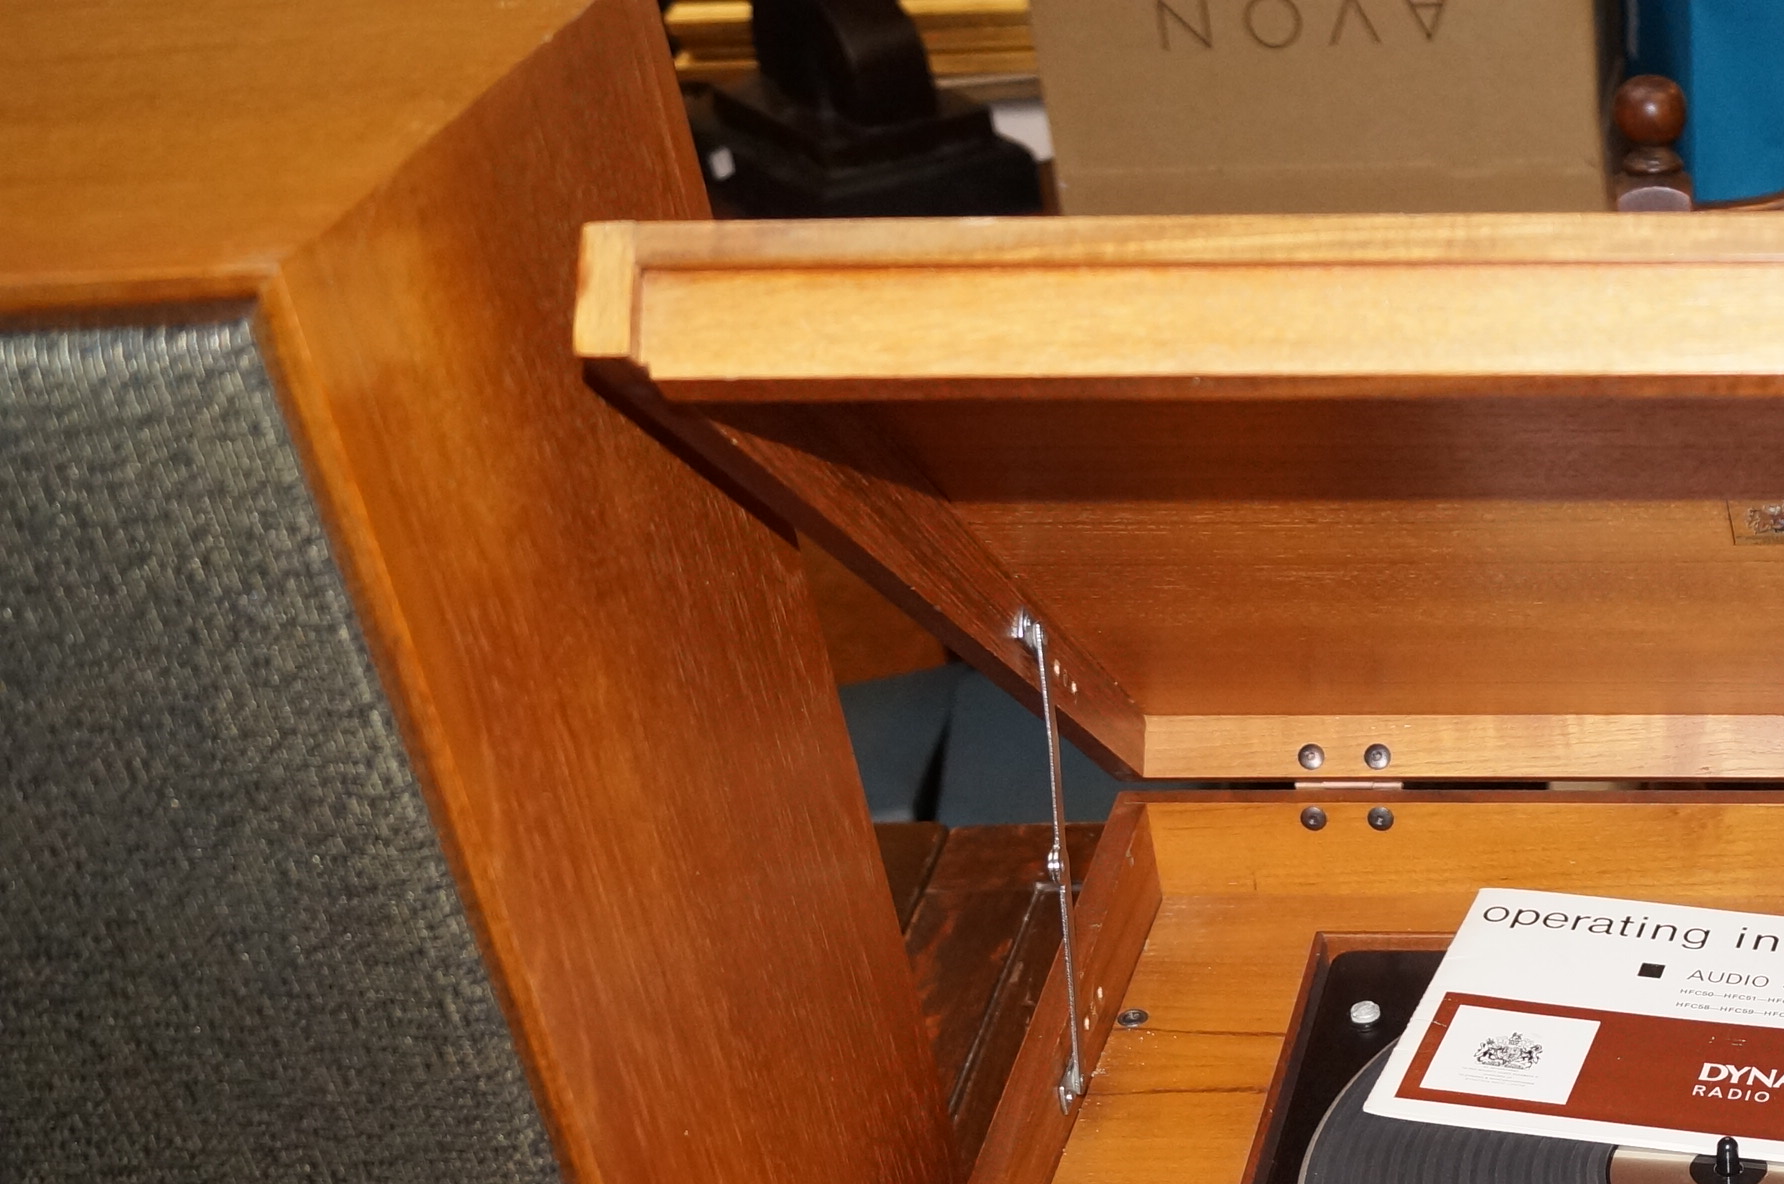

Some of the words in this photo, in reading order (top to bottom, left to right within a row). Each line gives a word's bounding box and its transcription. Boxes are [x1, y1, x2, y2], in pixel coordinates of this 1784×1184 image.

[1153, 0, 1448, 51] AVON
[1483, 906, 1711, 950] operating
[1686, 969, 1770, 988] AUDIO
[1692, 1084, 1770, 1103] RADIO
